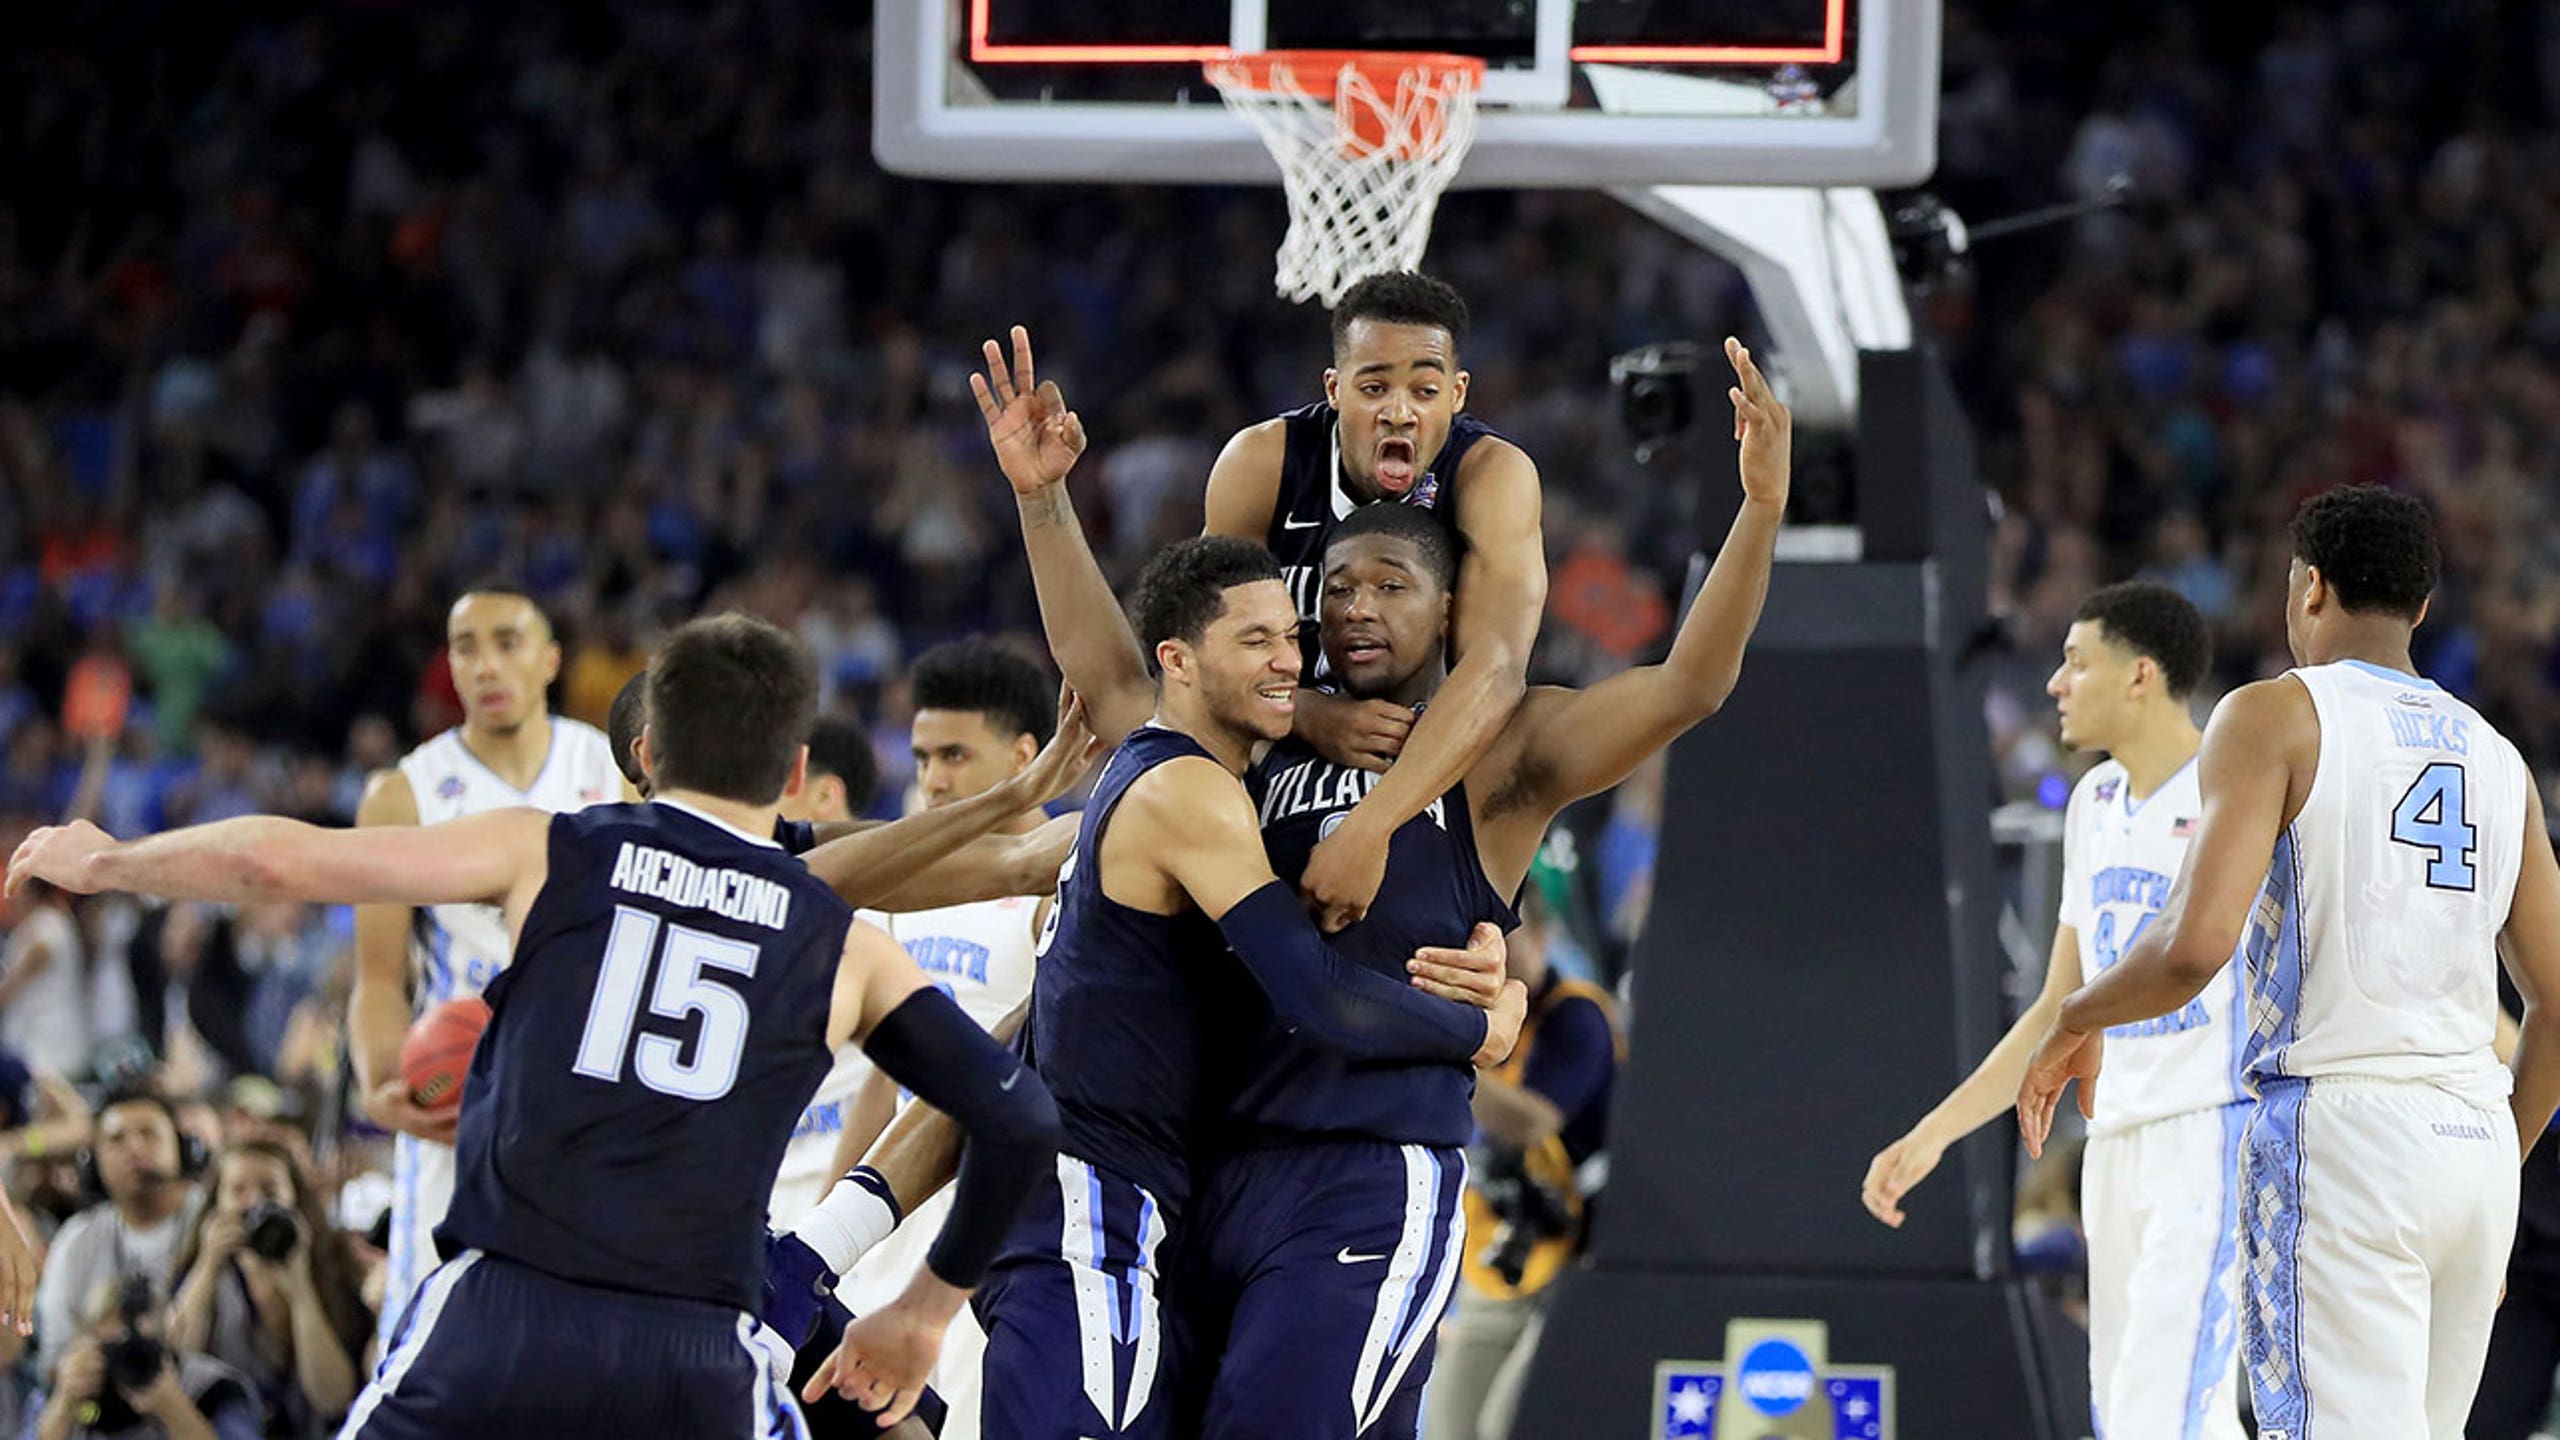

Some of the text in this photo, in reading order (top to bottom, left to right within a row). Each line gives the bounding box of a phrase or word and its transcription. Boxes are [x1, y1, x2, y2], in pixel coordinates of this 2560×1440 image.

[2384, 706, 2468, 757] HICKS
[1260, 757, 1447, 832] VILLAA
[2390, 761, 2477, 893] 4
[610, 841, 791, 931] ARCIDIACONO
[571, 903, 761, 1101] 15
[2430, 1123, 2491, 1141] CAROLINA
